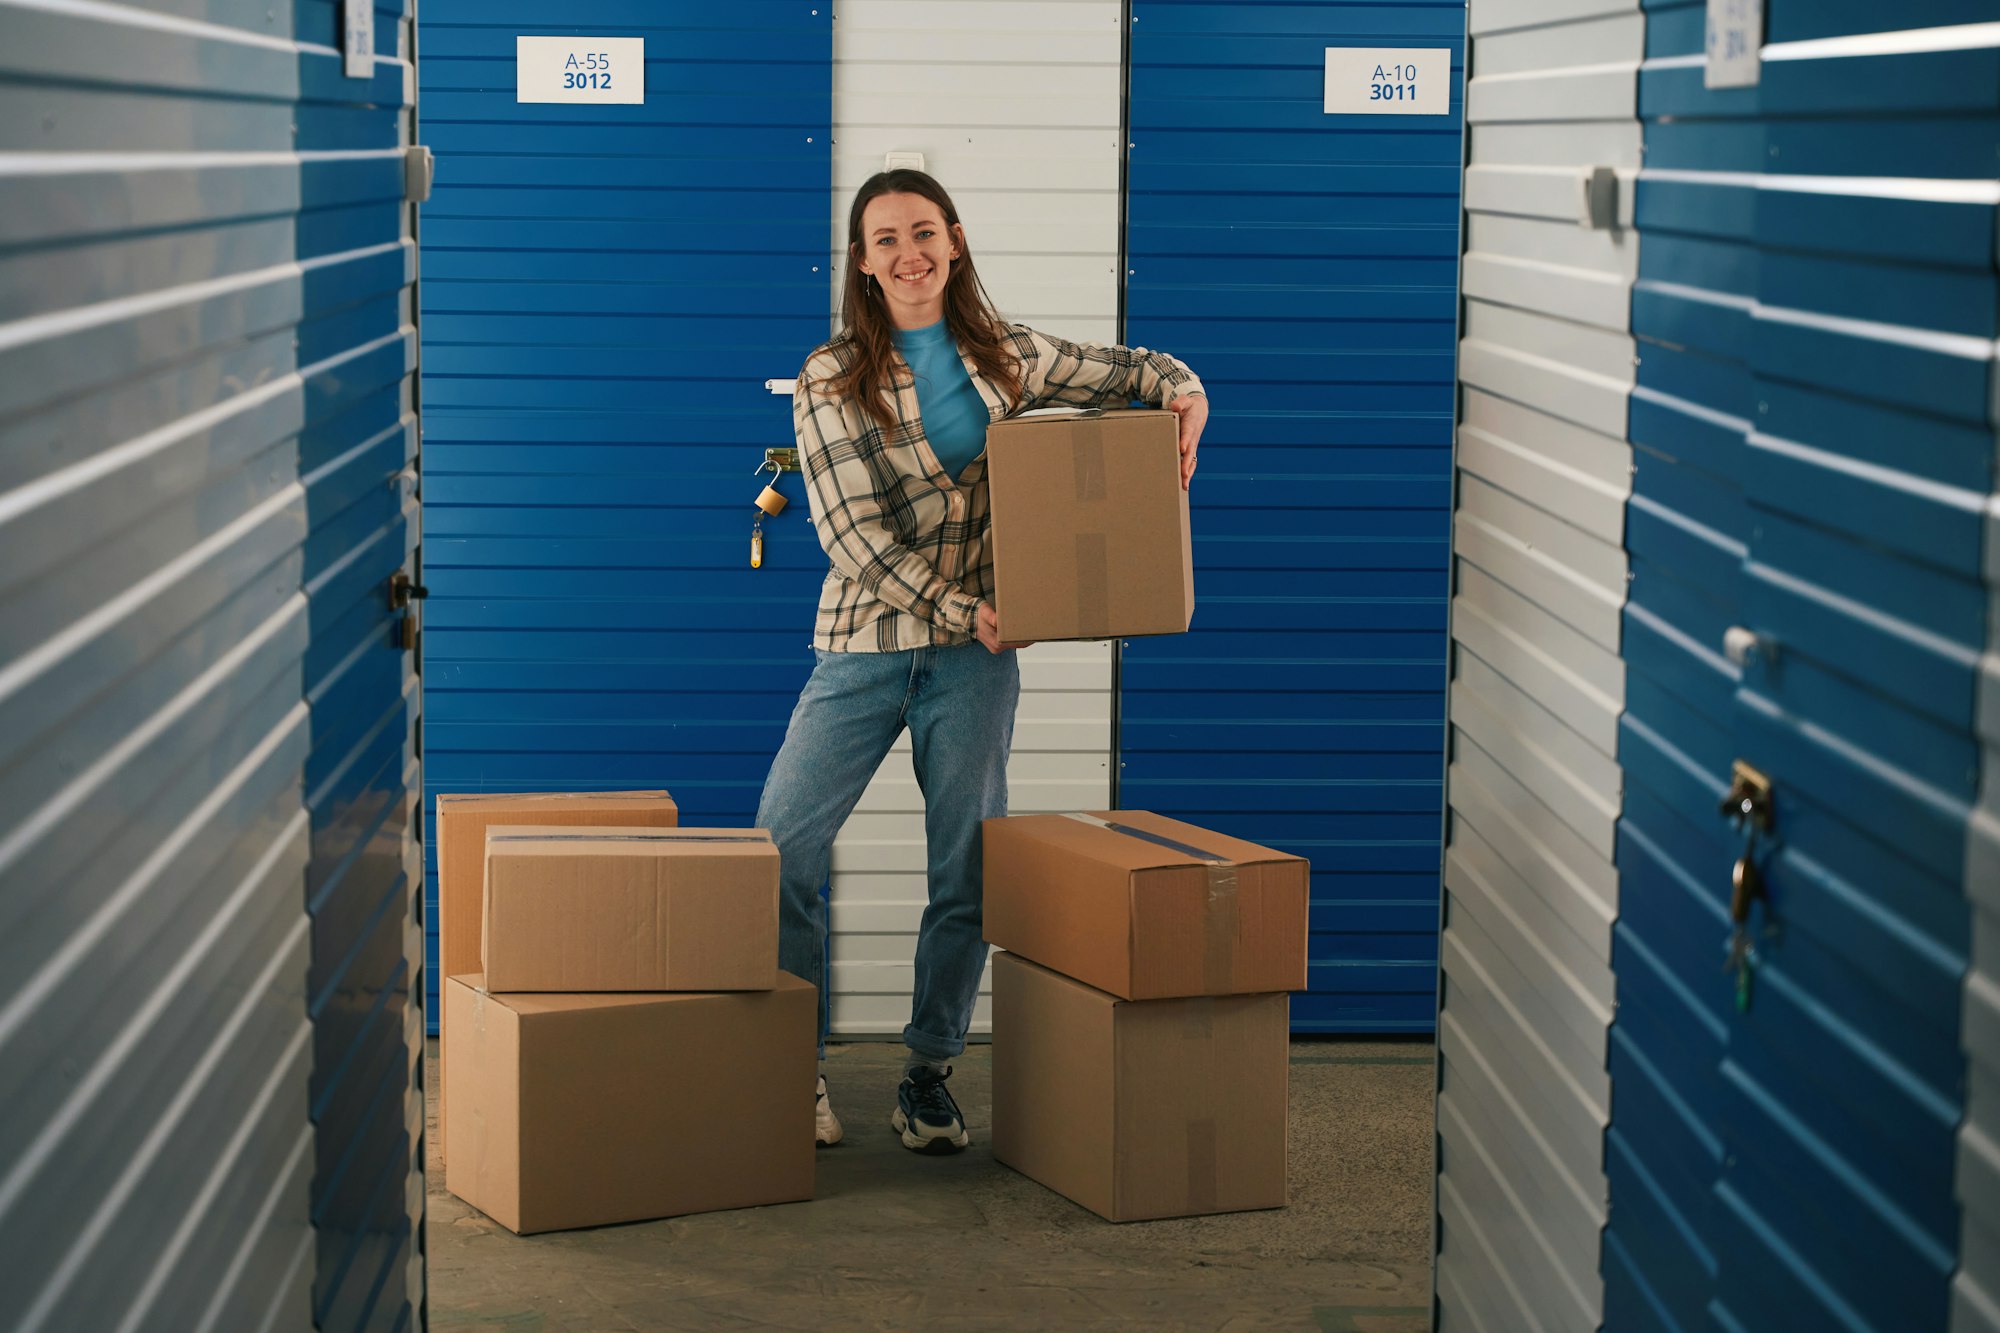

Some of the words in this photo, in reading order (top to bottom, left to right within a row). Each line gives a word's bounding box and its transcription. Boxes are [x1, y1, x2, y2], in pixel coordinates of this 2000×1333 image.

[565, 53, 609, 70] A-55
[563, 72, 612, 89] 3012
[1372, 64, 1417, 81] A-10
[1370, 83, 1416, 100] 3011
